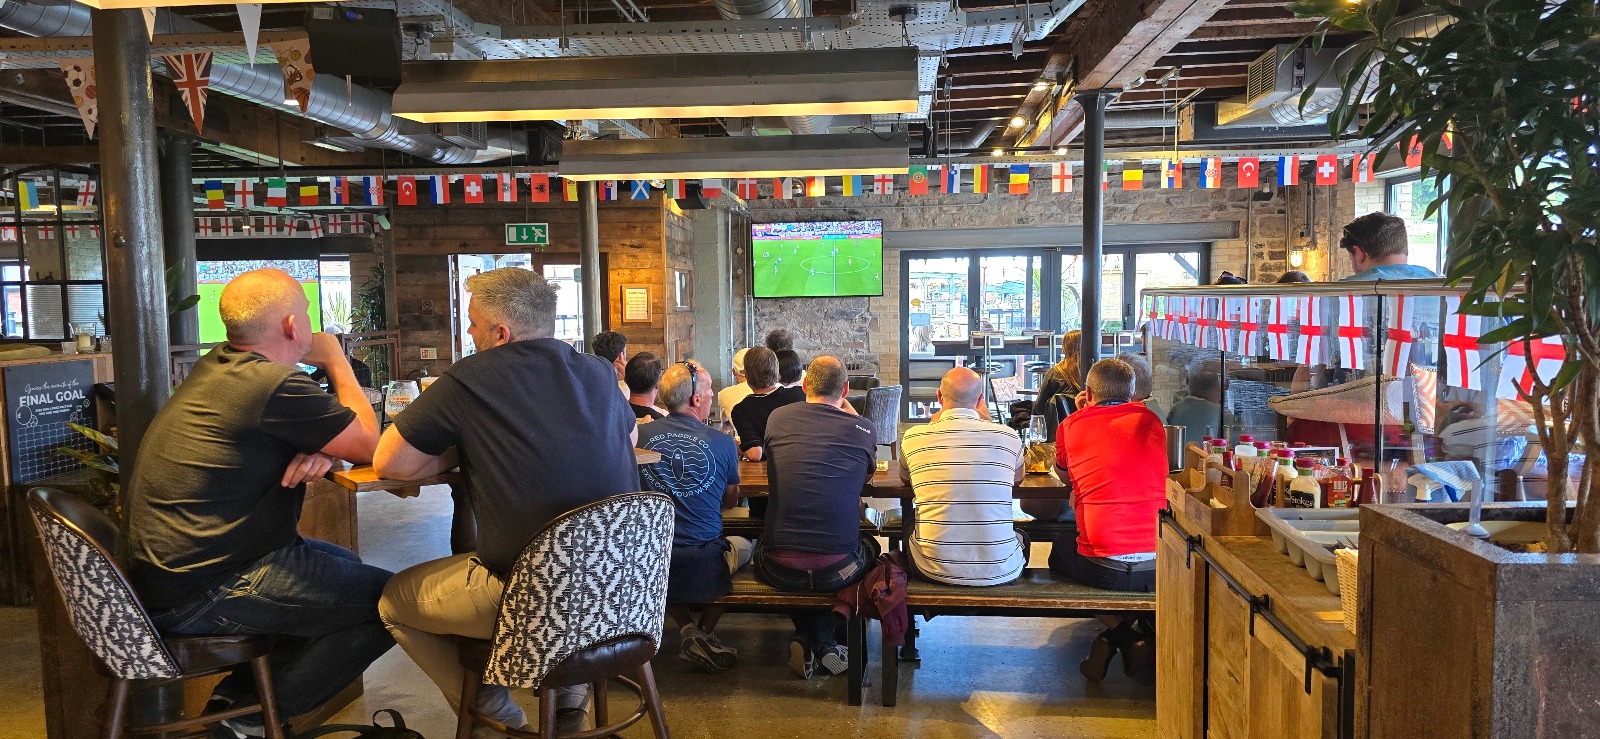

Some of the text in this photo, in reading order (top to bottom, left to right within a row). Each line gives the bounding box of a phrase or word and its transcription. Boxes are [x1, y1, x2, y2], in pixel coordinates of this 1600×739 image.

[24, 383, 42, 394] Guess
[42, 381, 50, 390] the
[71, 378, 79, 387] the
[19, 389, 86, 407] FINAL GOAL
[649, 432, 709, 449] RED PADDLE CO
[642, 468, 716, 497] EXPLORE YOUR WORLD
[1290, 495, 1314, 507] Stokes
